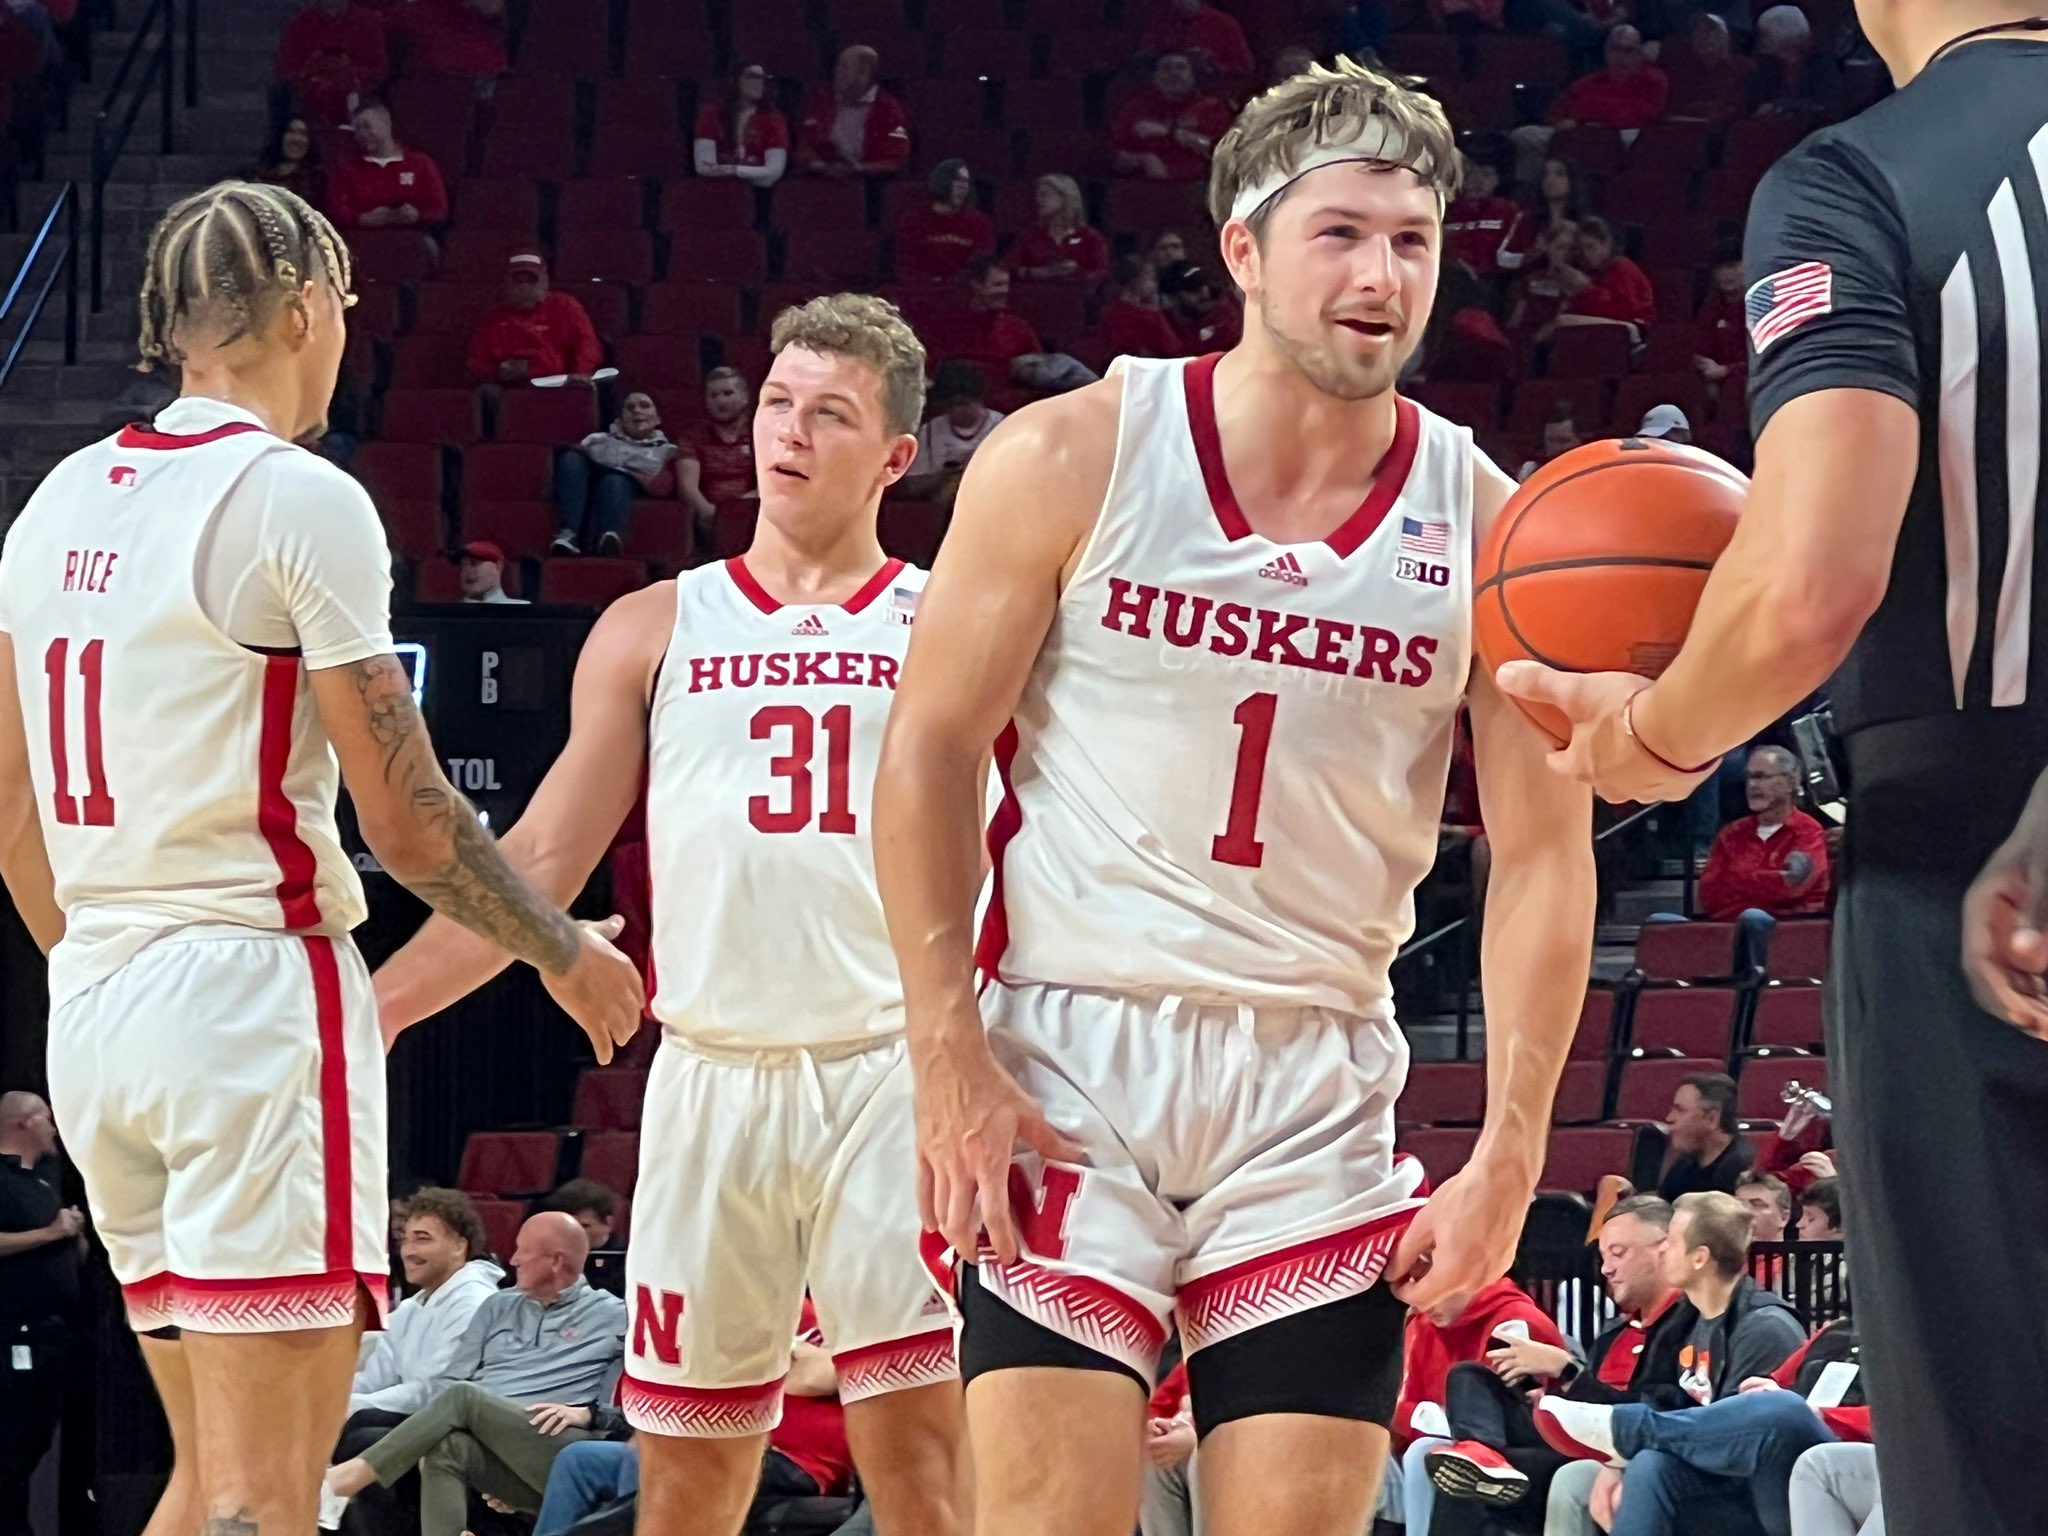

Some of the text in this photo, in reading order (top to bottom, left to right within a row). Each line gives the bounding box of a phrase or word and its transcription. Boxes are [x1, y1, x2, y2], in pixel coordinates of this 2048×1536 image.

[63, 549, 118, 592] RICE
[688, 652, 899, 693] HUSKER
[1101, 577, 1438, 687] HUSKERS
[45, 638, 115, 827] 11
[749, 705, 856, 834] 31
[1211, 692, 1278, 868] 1
[633, 1282, 685, 1368] N
